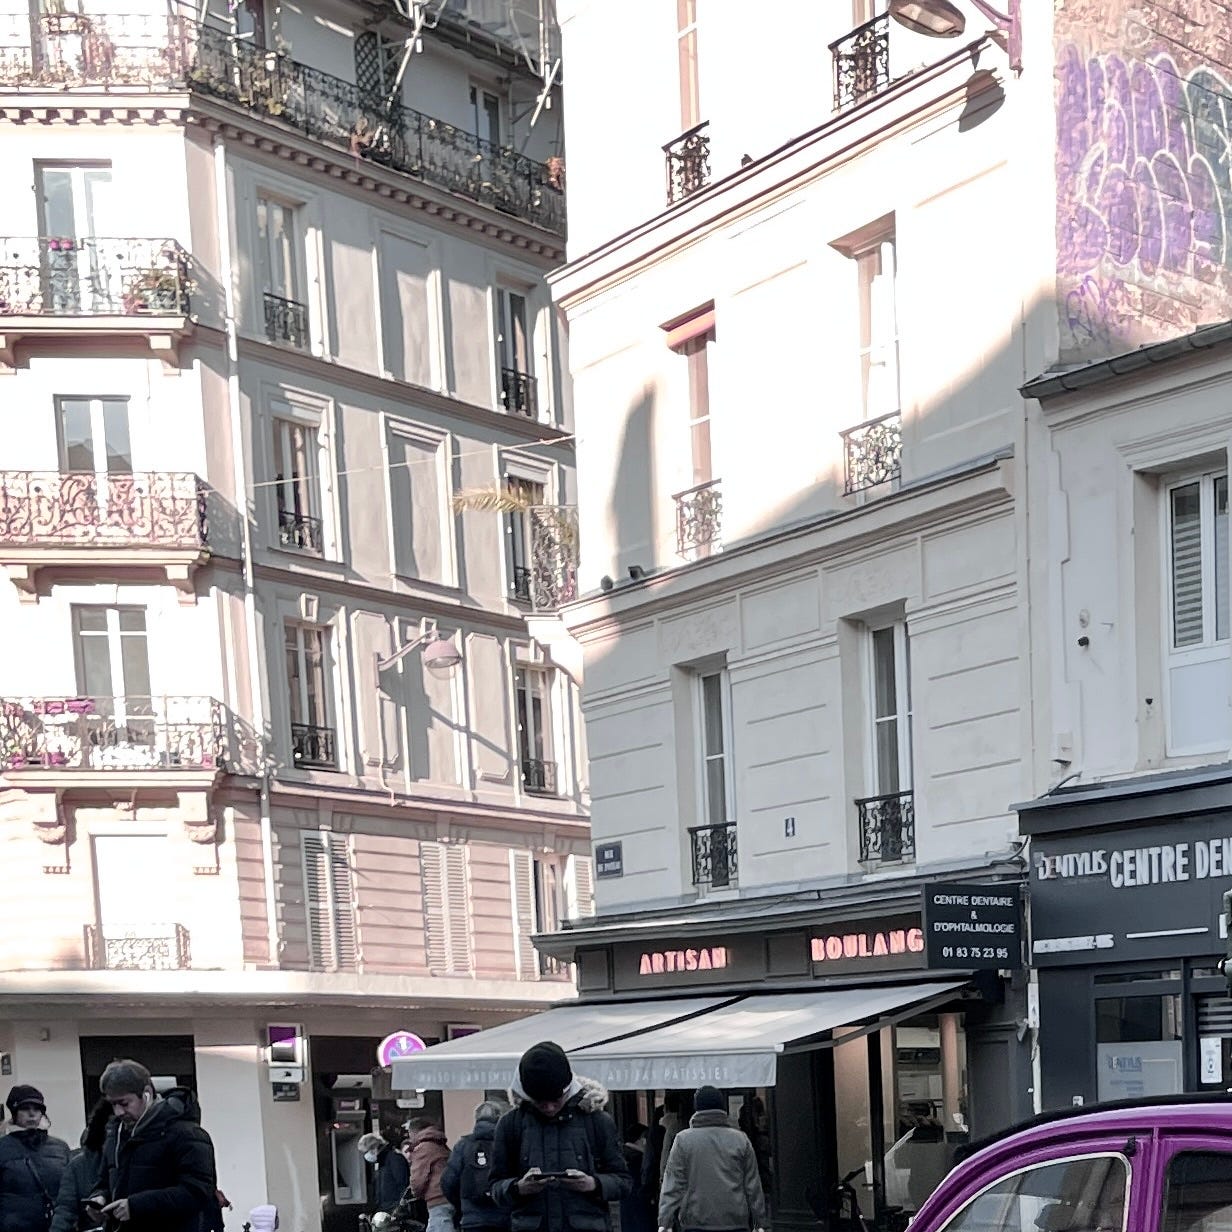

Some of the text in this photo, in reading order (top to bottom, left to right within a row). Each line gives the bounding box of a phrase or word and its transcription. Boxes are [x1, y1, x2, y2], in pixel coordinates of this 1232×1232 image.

[1110, 843, 1190, 888] CENTRE
[933, 895, 1014, 907] CENTRE DENTAIRE
[970, 910, 978, 920] &
[933, 922, 1015, 933] D'OPHTALMOLOGIE
[811, 929, 924, 961] BOULANG
[942, 946, 1009, 958] 01 83 75 23 95
[639, 947, 727, 975] ARTISAN
